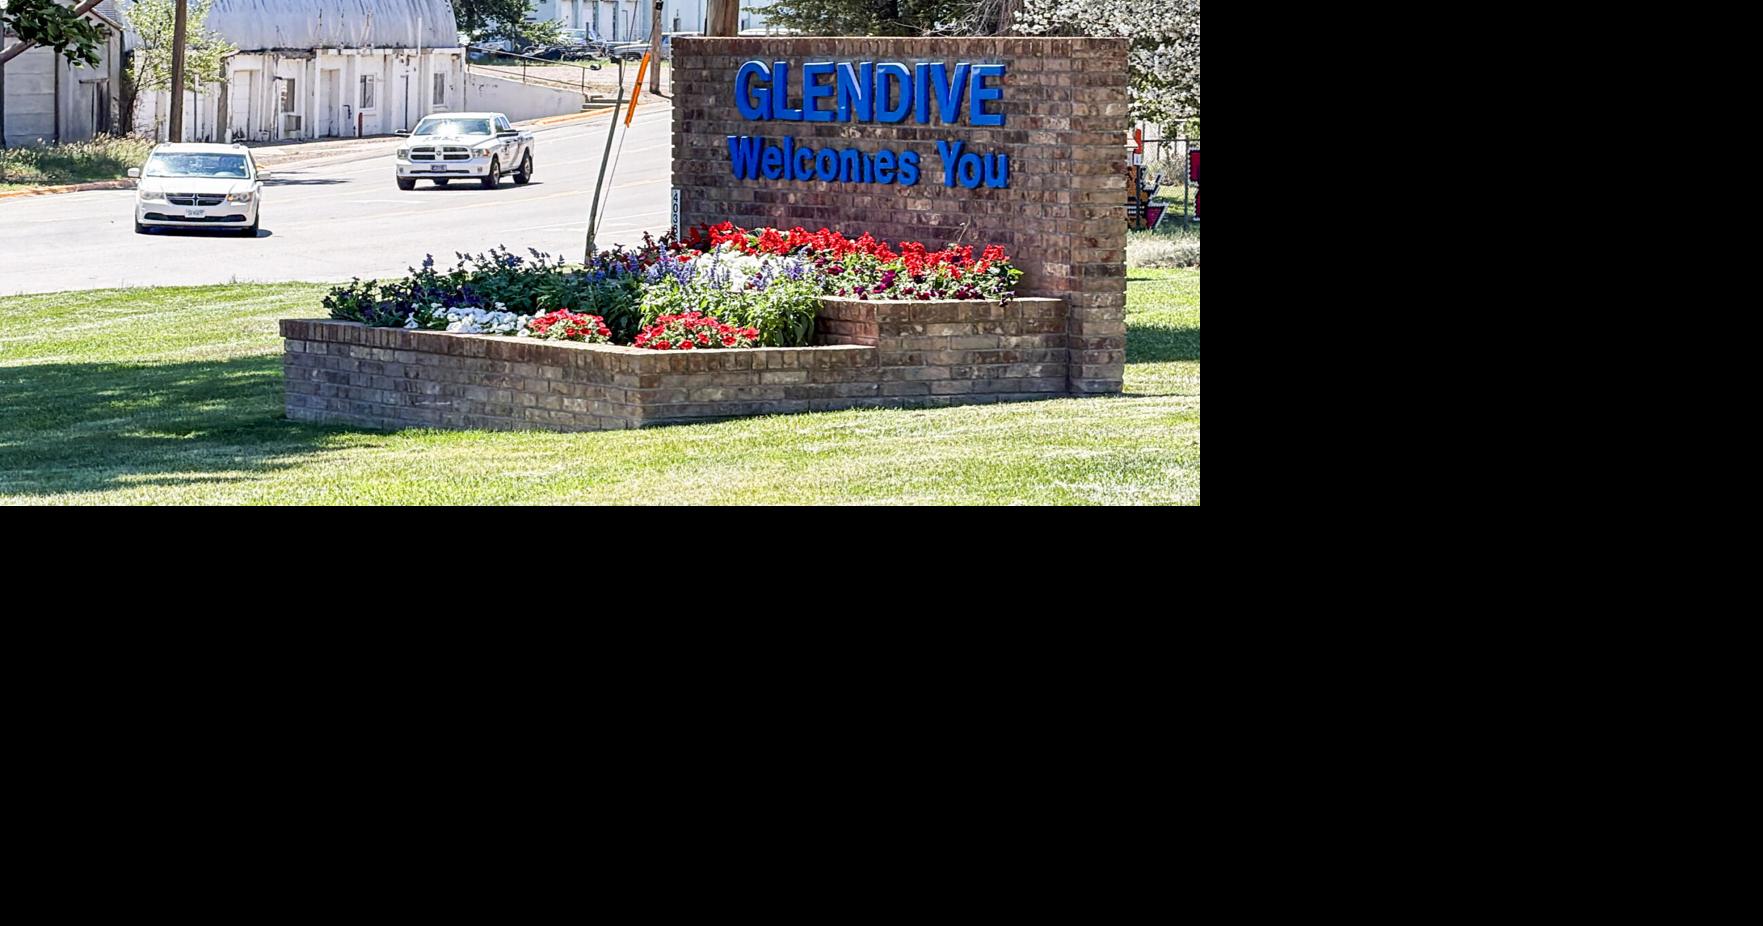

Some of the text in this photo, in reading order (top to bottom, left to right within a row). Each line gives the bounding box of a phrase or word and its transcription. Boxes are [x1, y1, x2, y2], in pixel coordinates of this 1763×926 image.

[735, 60, 1006, 126] GLENDIVE
[727, 135, 1010, 189] Welcomes You
